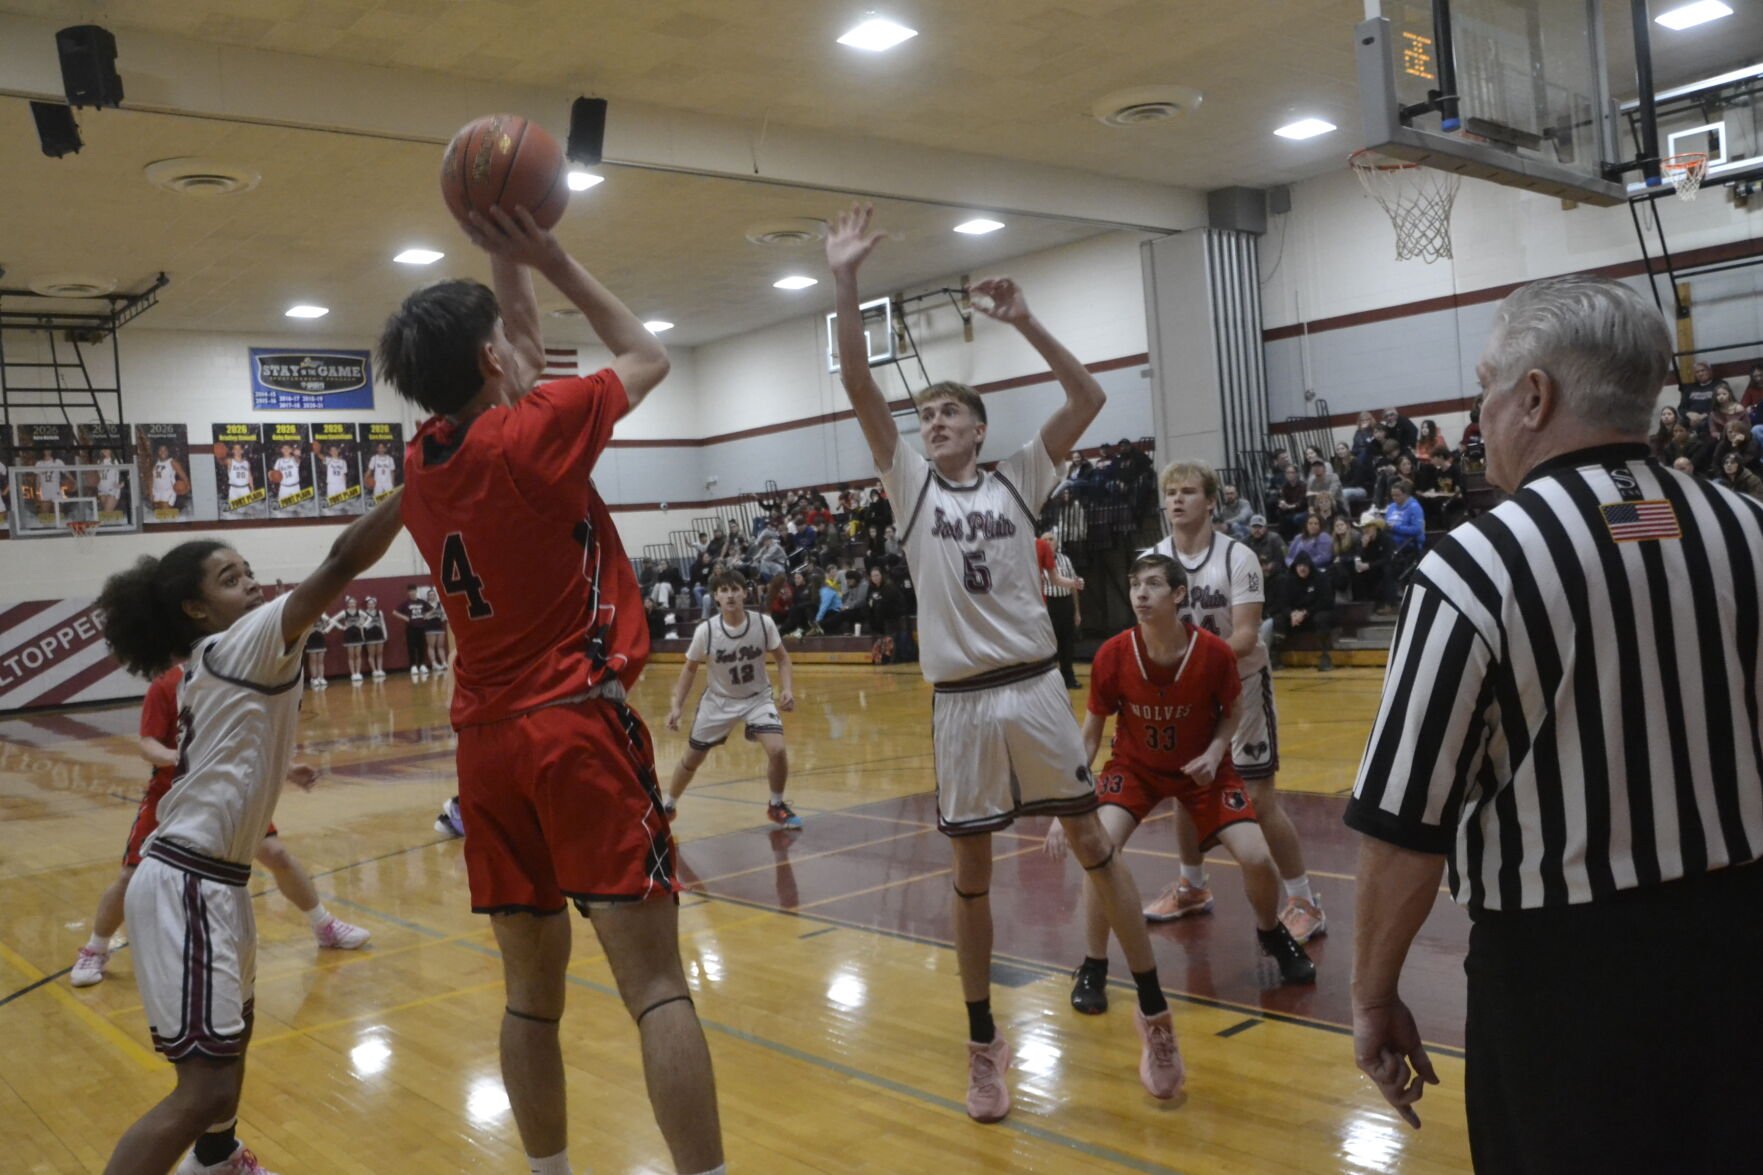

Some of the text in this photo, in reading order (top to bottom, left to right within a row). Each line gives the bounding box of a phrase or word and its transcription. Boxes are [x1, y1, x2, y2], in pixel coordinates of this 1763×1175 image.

[263, 364, 300, 377] STAY
[317, 365, 361, 377] GAME
[149, 423, 175, 434] 2026
[225, 424, 248, 434] 2026
[275, 424, 297, 434] 2026
[322, 423, 344, 433] 2026
[370, 424, 391, 433] 2026
[965, 510, 1017, 542] Plain
[440, 530, 494, 621] 4
[962, 550, 993, 594] 5
[728, 663, 755, 685] 12
[1128, 702, 1193, 721] WOLVES
[1144, 722, 1177, 753] 33
